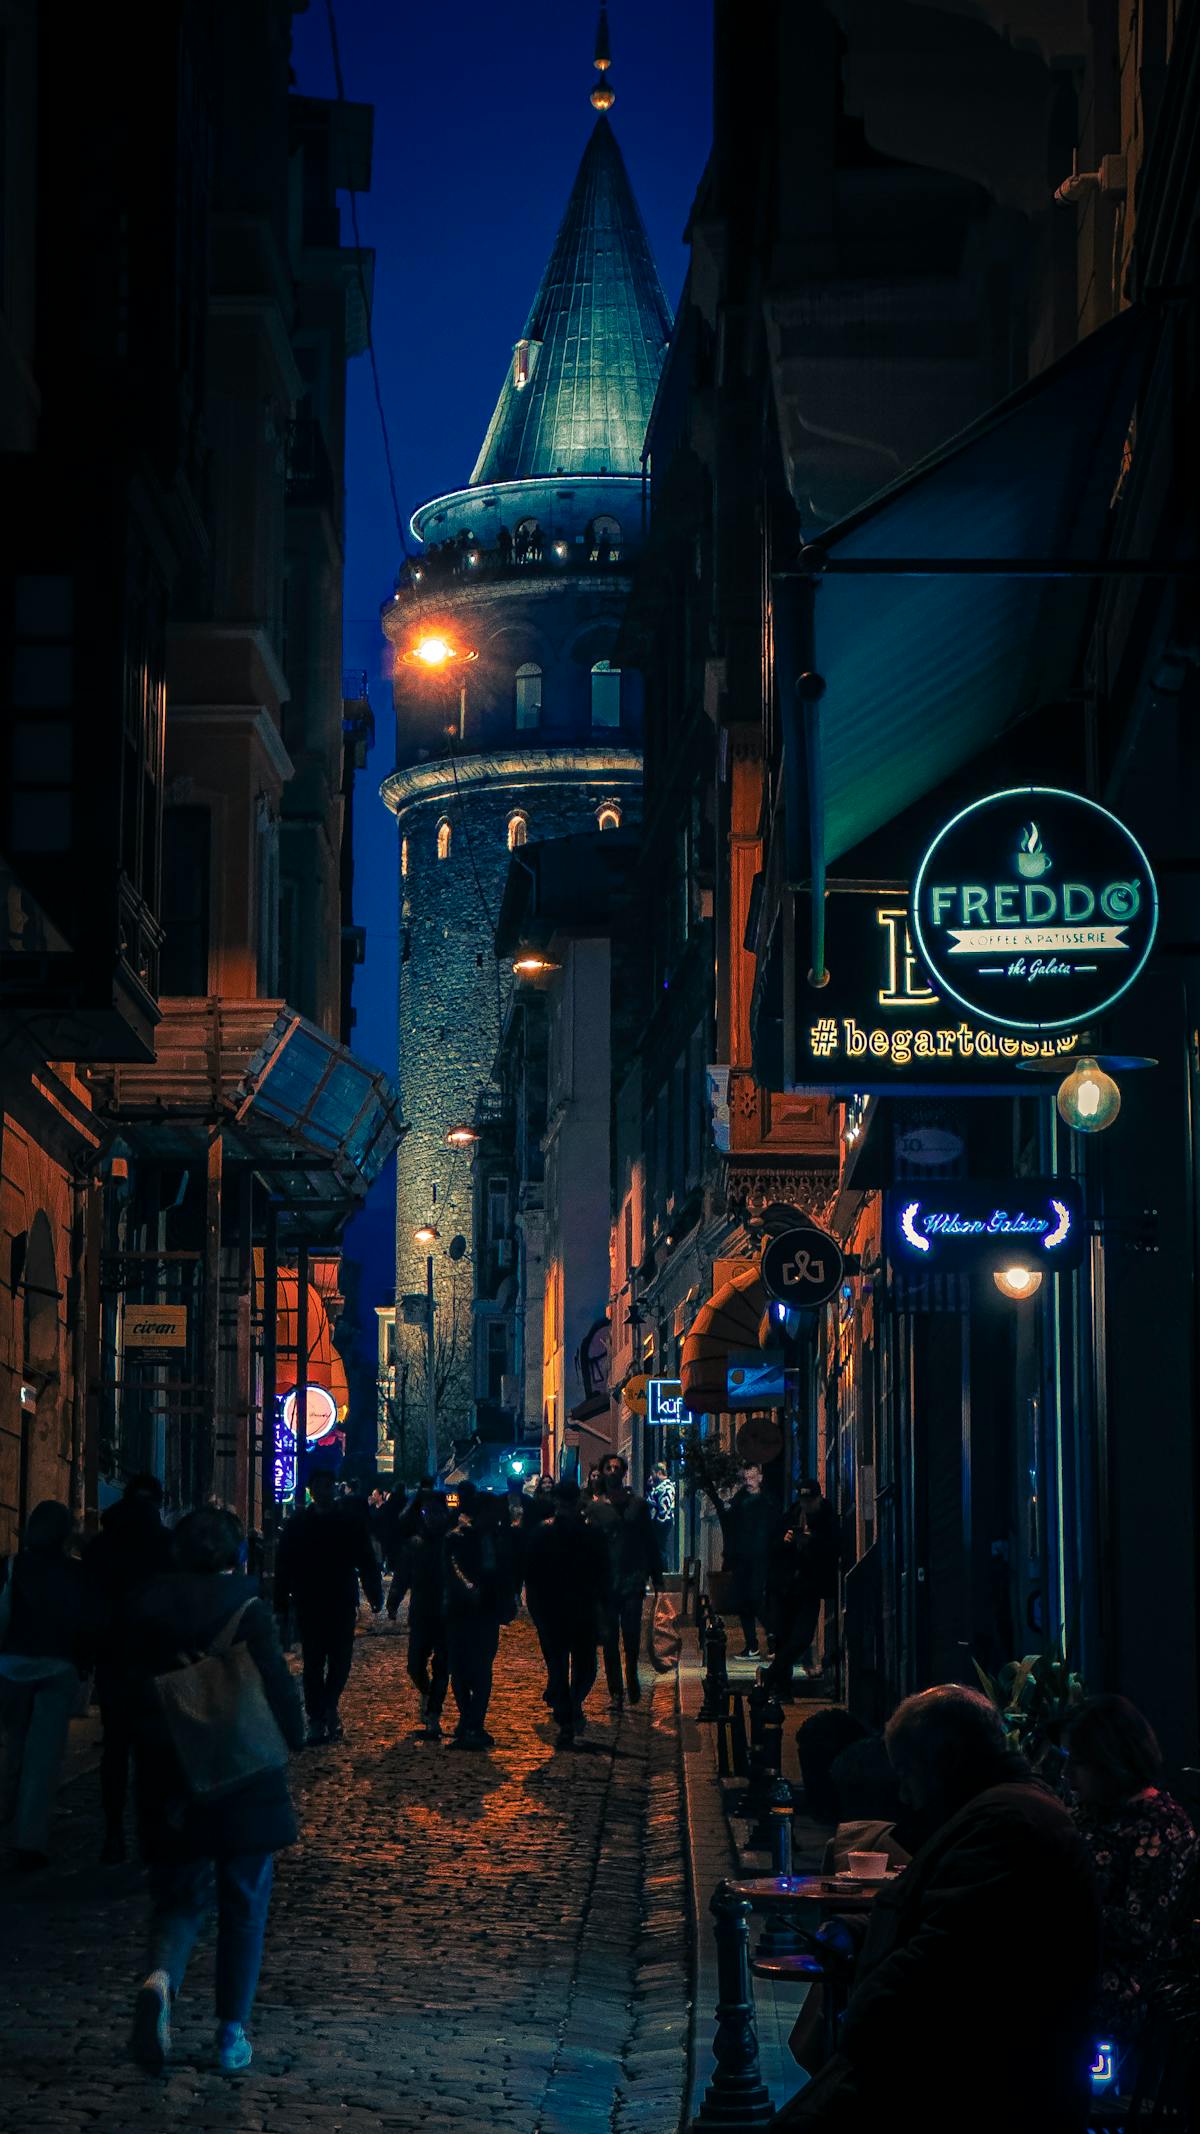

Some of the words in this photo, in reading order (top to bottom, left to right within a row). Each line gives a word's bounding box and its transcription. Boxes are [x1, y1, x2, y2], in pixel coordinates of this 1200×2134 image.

[932, 880, 1140, 925] FREDDO
[969, 935, 1018, 946] COFFEE
[1024, 935, 1033, 945] &
[1037, 932, 1106, 945] PATISSERIE
[1007, 957, 1026, 976] the
[1028, 957, 1072, 982] Galata
[923, 1213, 985, 1233] Wilson
[986, 1210, 1049, 1233] Galata
[657, 1396, 683, 1414] küf
